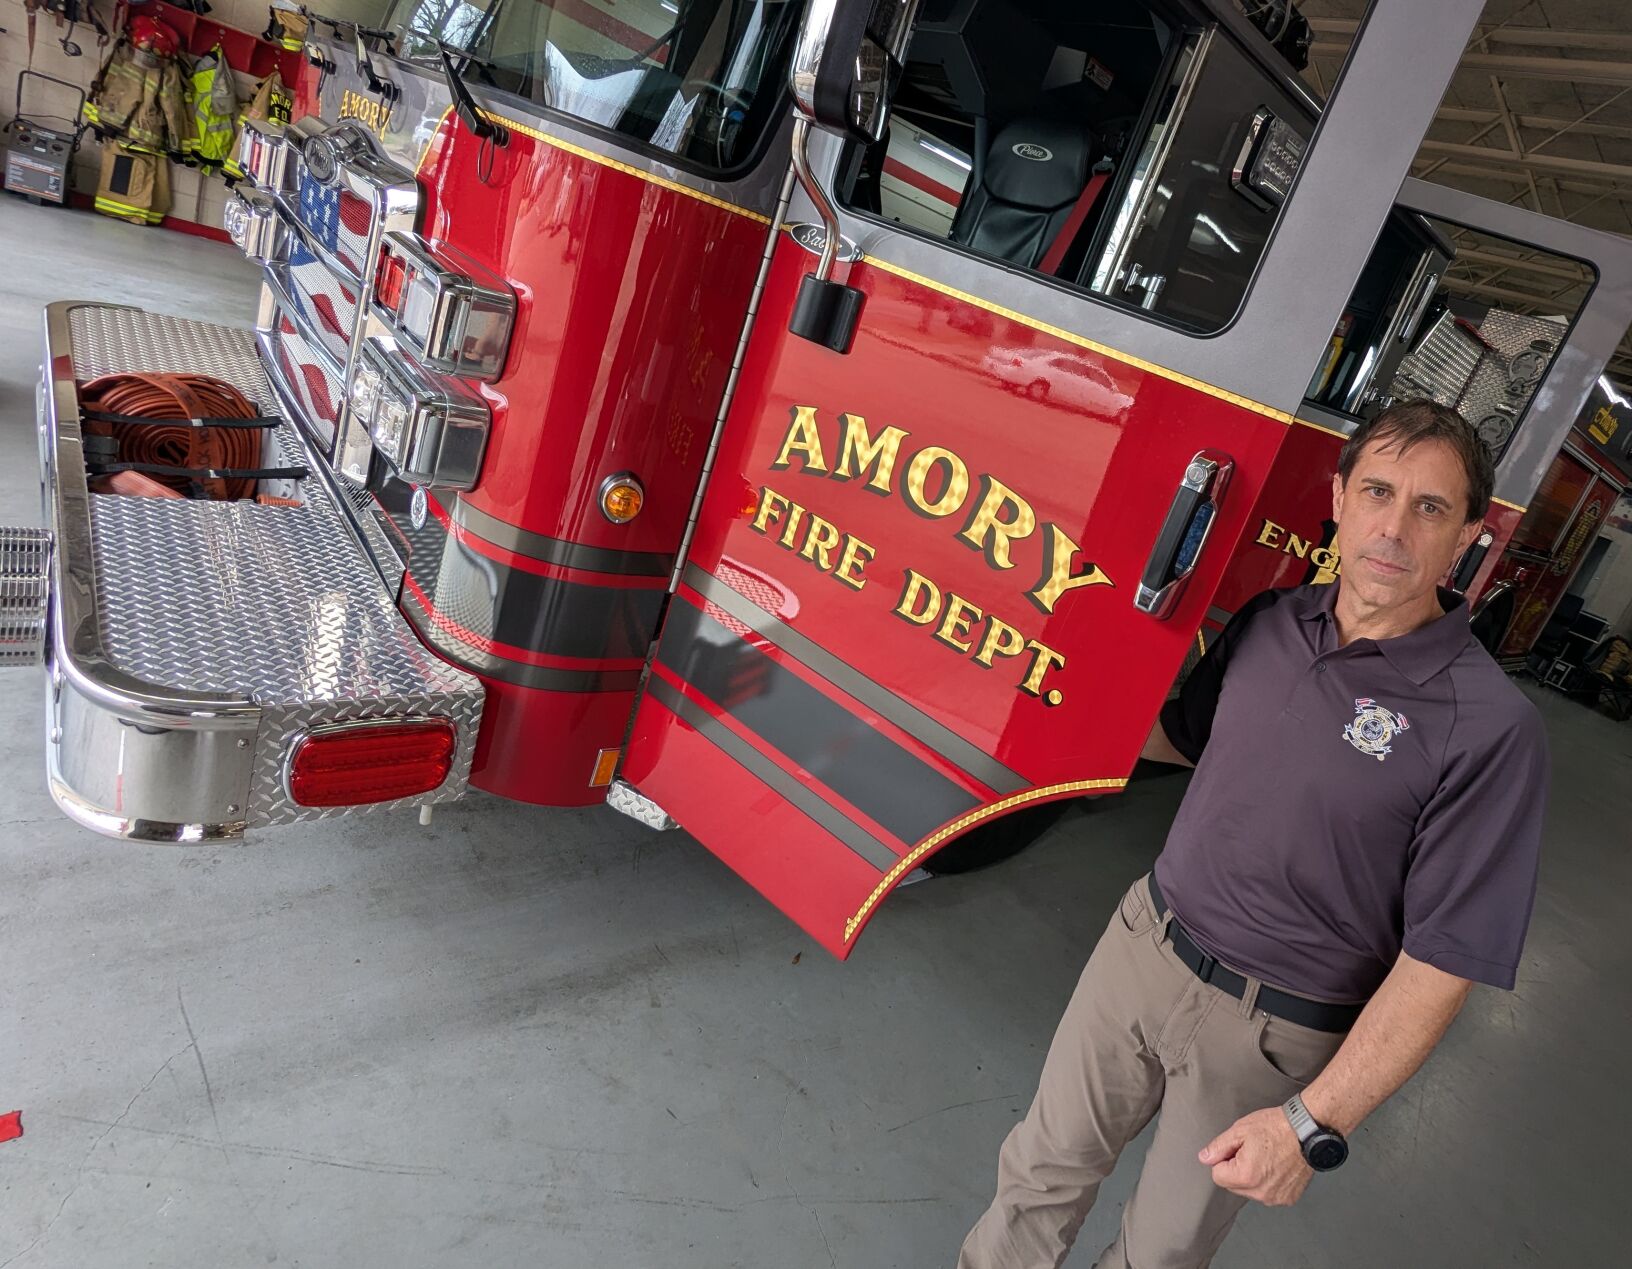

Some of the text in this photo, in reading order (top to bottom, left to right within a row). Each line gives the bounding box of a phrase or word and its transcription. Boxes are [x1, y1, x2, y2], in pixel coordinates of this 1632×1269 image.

[337, 89, 393, 142] AMORY
[801, 228, 843, 249] Sab
[769, 405, 1116, 614] AMORY
[749, 486, 1066, 706] FIRE DEPT.
